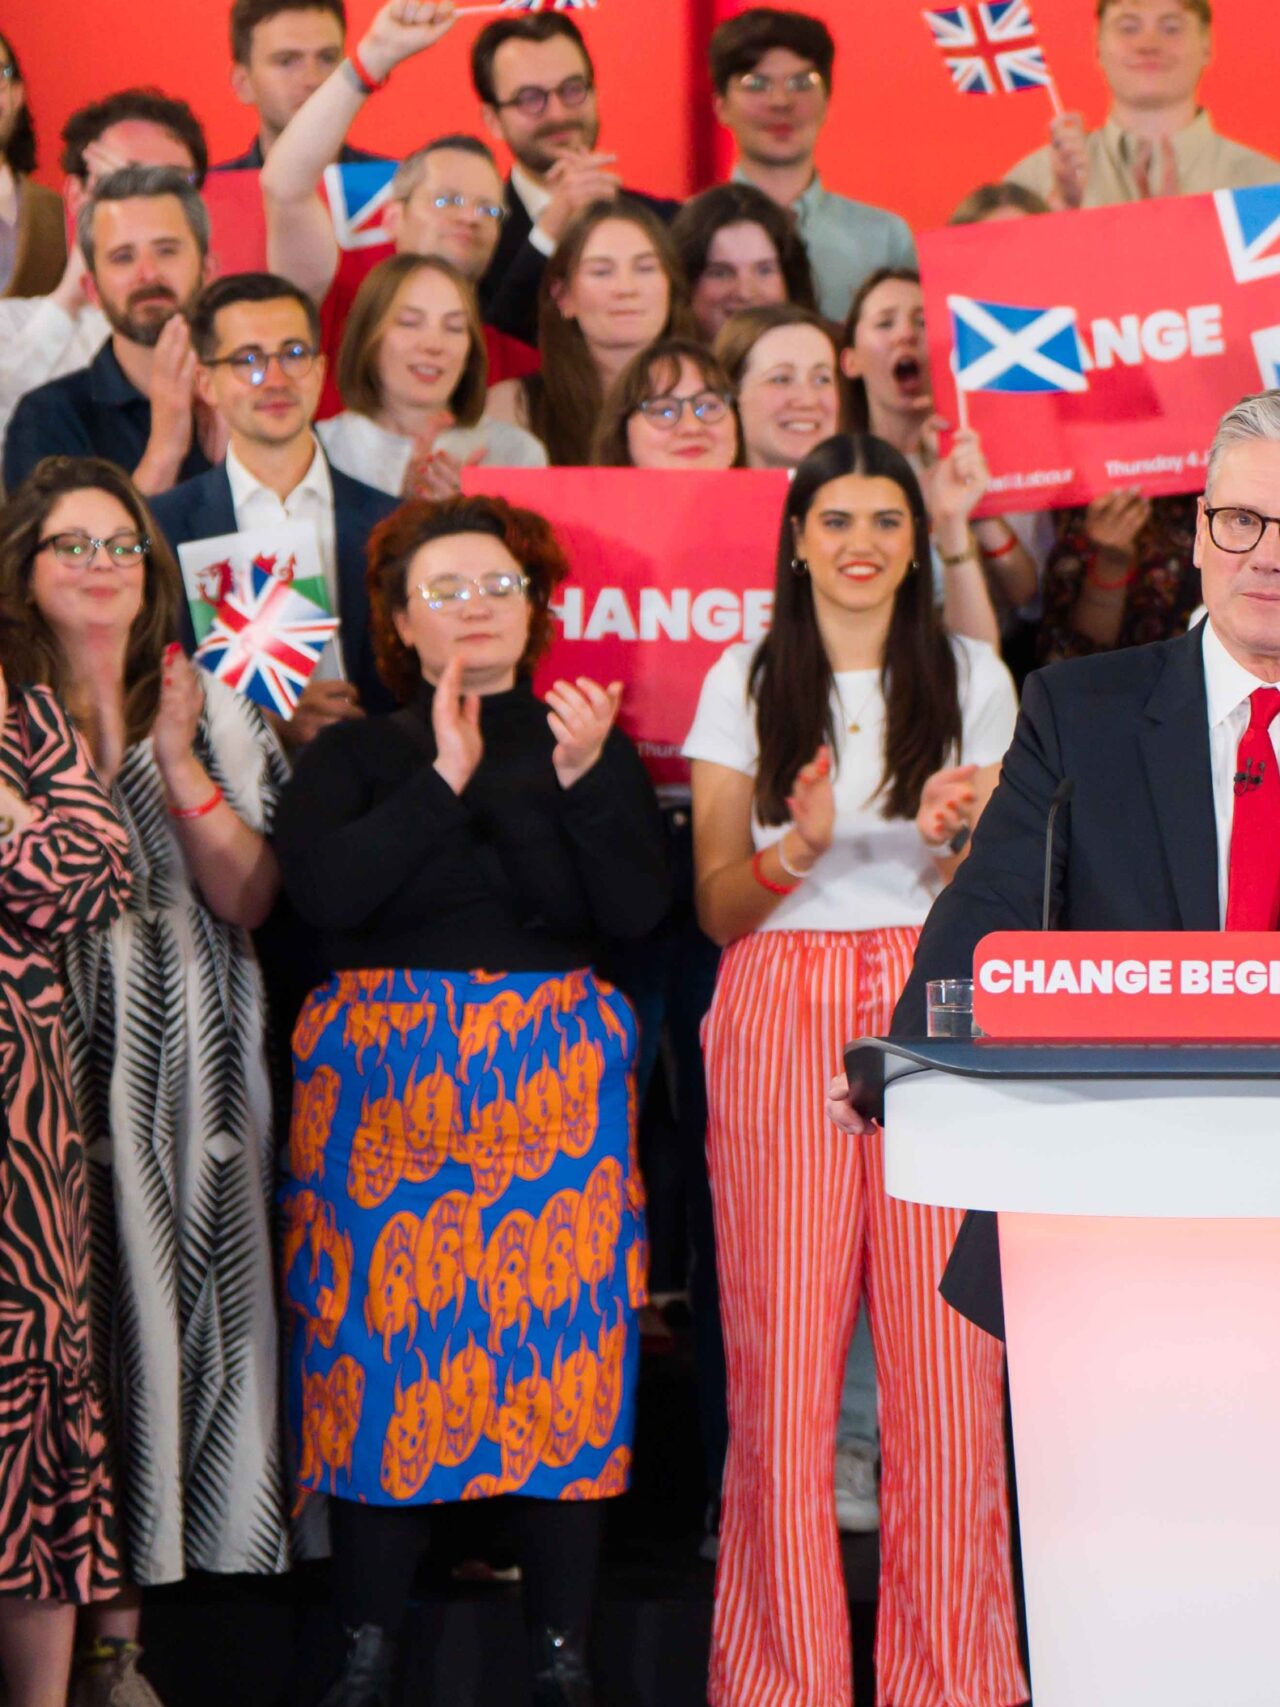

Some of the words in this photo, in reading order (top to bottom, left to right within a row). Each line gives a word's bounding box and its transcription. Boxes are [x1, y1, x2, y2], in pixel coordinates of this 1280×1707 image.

[1104, 454, 1184, 478] Thursday
[1187, 450, 1198, 466] 4
[548, 587, 776, 642] HANGE
[979, 959, 1172, 995] CHANGE
